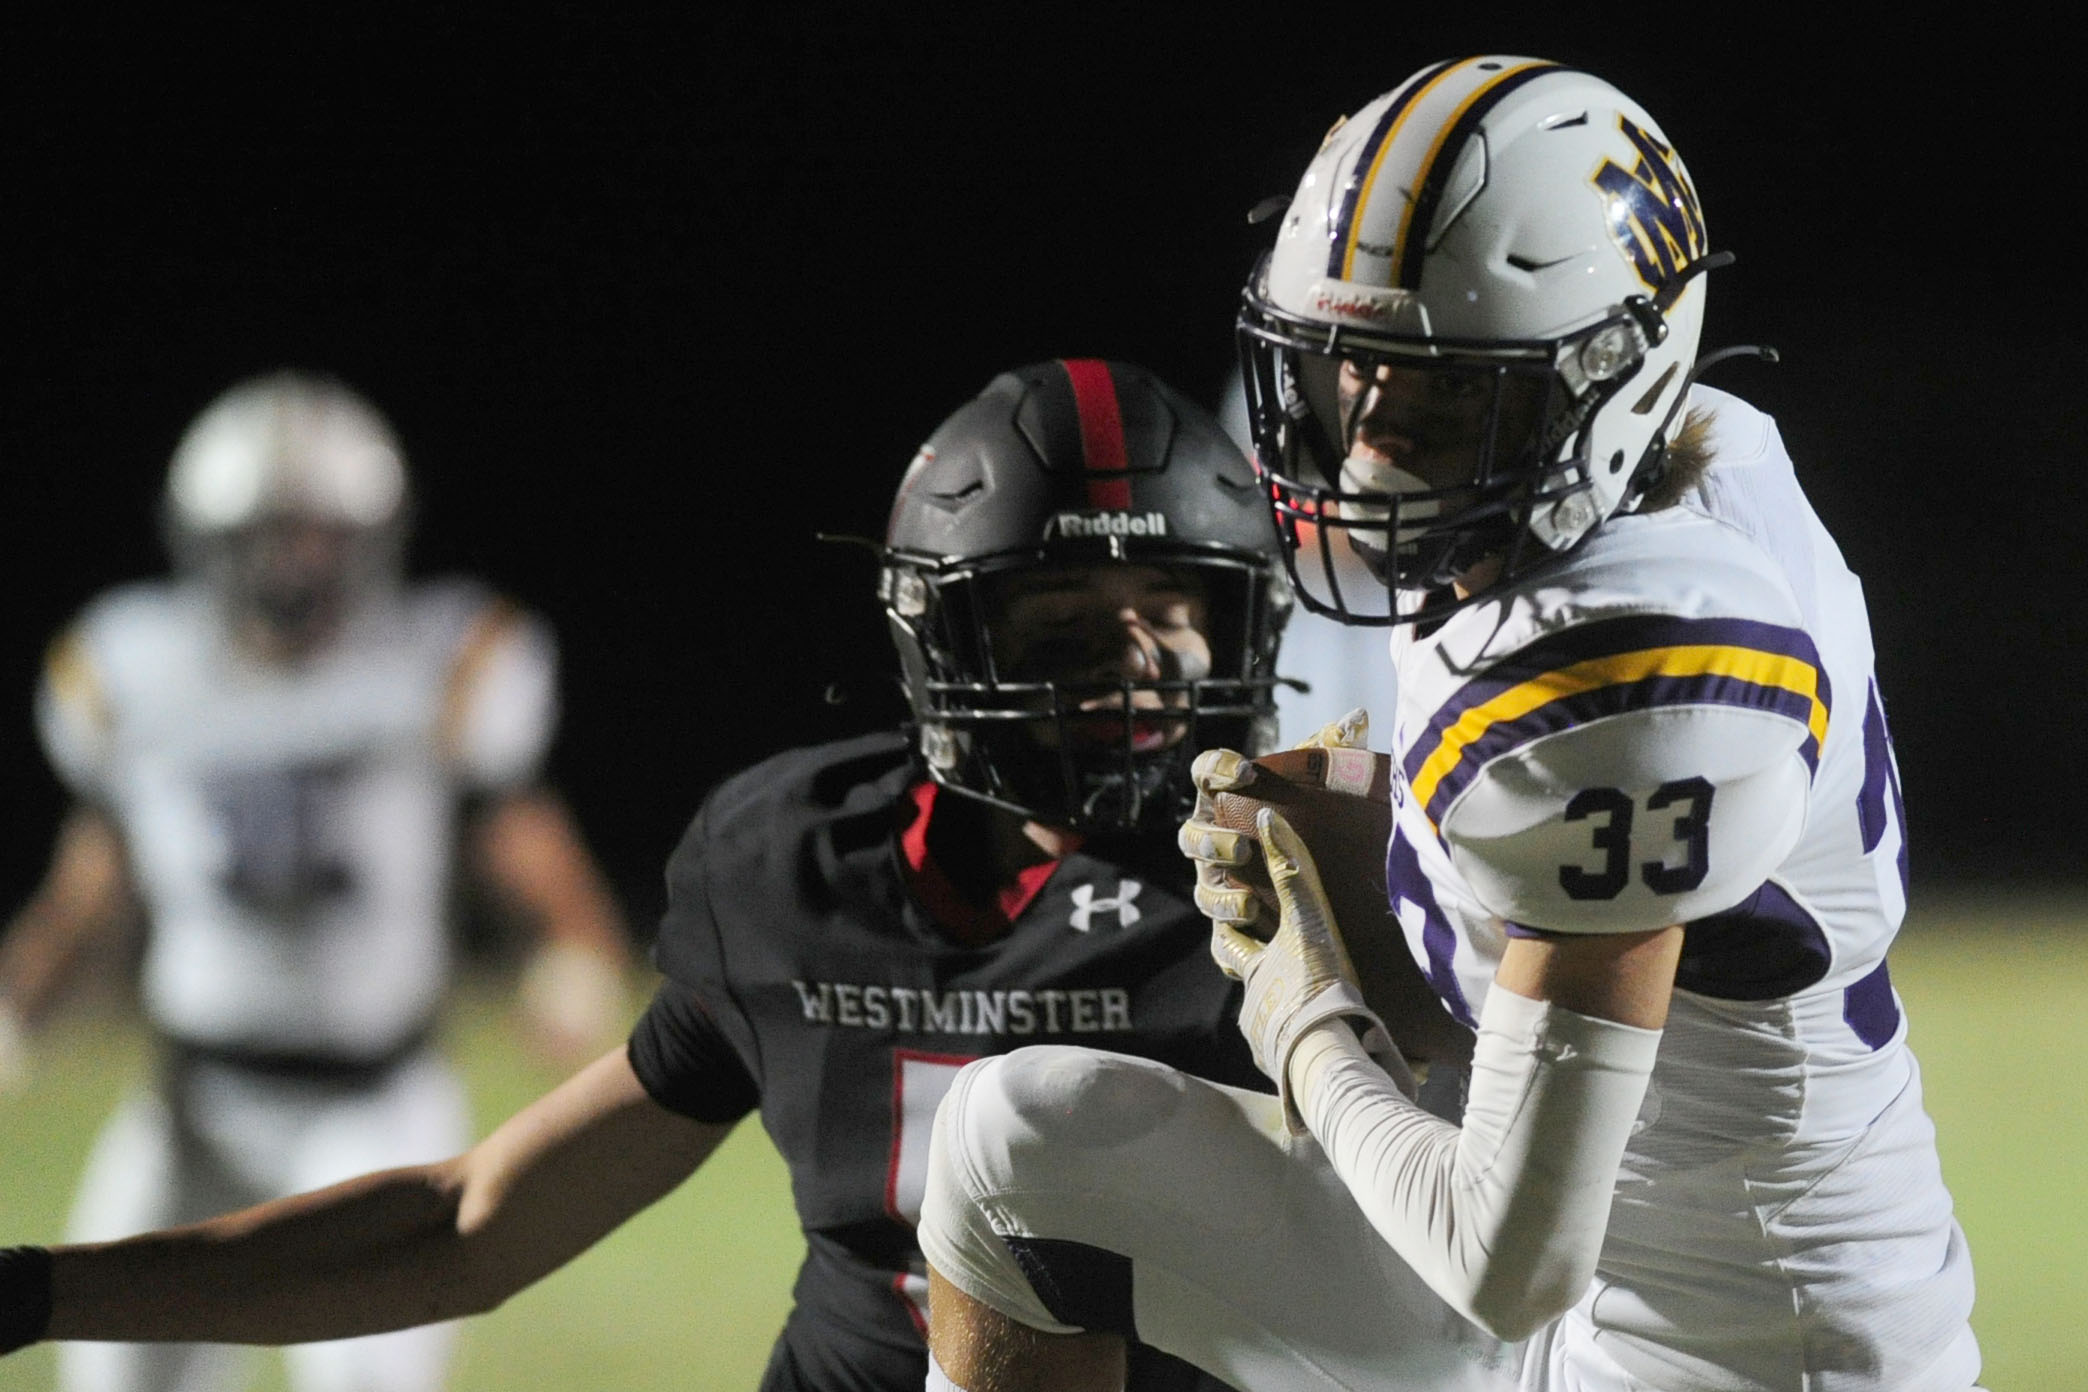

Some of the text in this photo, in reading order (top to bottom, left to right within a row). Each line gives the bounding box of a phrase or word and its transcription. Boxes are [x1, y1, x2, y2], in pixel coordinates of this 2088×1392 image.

[1059, 512, 1166, 536] Riddell
[1559, 776, 1716, 900] 33
[794, 980, 1132, 1033] WESTMINSTER
